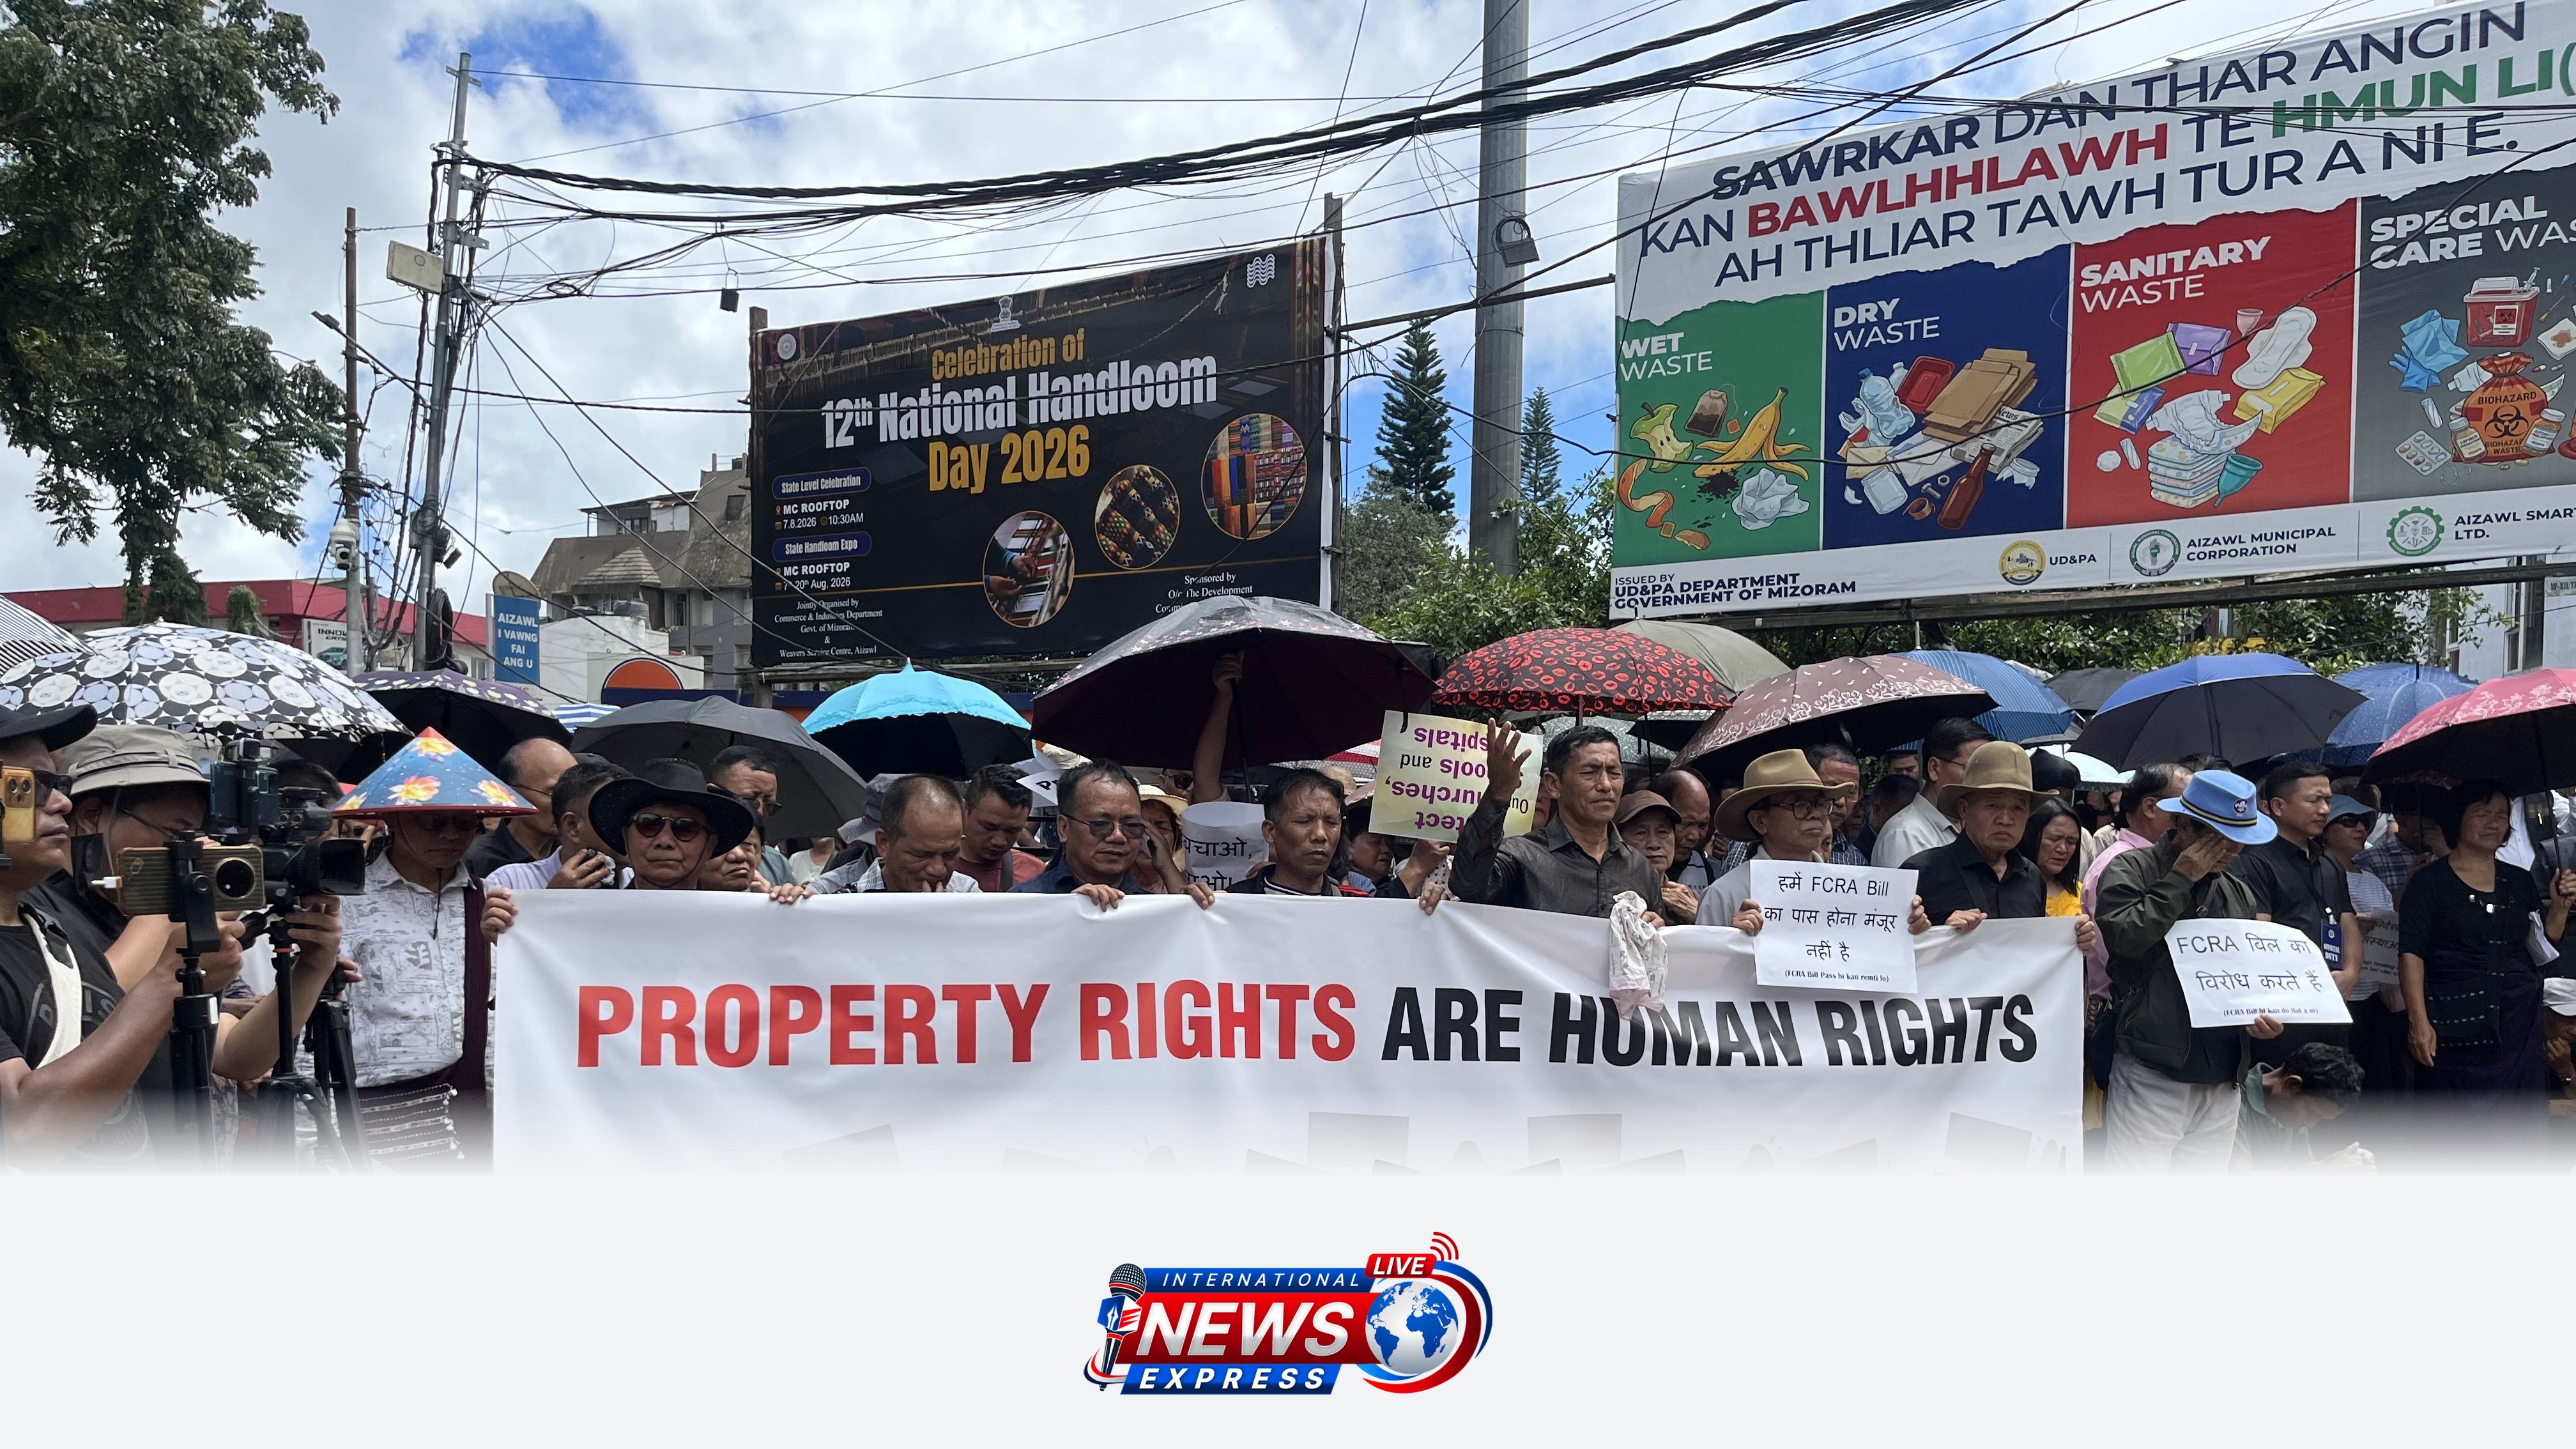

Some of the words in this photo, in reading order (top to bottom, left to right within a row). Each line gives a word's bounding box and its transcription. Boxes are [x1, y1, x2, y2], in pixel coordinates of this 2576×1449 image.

[1712, 116, 1981, 201] SAWRKAR
[1995, 84, 2117, 144] DAN
[2131, 50, 2297, 107] THAR
[2310, 1, 2526, 81] ANGIN
[1641, 210, 1733, 257] KAN
[1748, 123, 2168, 238] BAWLHHLAWH
[2182, 107, 2255, 153] TE
[2273, 64, 2476, 139] HMUN
[1715, 244, 1782, 287] AH
[1794, 210, 1975, 282] THLIAR
[1986, 172, 2165, 237] TAWH
[2179, 149, 2304, 203] TUR
[2317, 139, 2366, 182] A
[2383, 123, 2443, 170] NI
[2466, 112, 2519, 157] E.
[2370, 195, 2549, 243] SPECIAL
[2370, 232, 2483, 270] CARE
[2080, 235, 2272, 288] SANITARY
[2080, 273, 2205, 314] WASTE
[1834, 298, 1901, 328] DRY
[1834, 316, 1940, 351] WASTE
[931, 334, 1055, 381] Celebration
[1062, 327, 1085, 362] of
[1620, 332, 1685, 358] WET
[1620, 350, 1713, 382] WASTE
[821, 396, 873, 448] 12th
[879, 376, 1016, 442] National
[1029, 355, 1216, 424] Handloom
[2478, 392, 2536, 404] BIOHAZARD
[929, 440, 988, 495] Day
[1000, 424, 1090, 486] 2026
[781, 482, 799, 493] State
[801, 479, 819, 491] Level
[820, 474, 861, 490] Celebration
[783, 504, 799, 515] MC
[801, 499, 850, 512] ROOFTOP
[2455, 512, 2521, 526] AIZAWL
[2526, 507, 2576, 521] SMAR
[783, 518, 816, 529] 7.8.2026
[828, 512, 864, 525] 10:30AM
[2187, 533, 2246, 549] AIZAWL
[2251, 526, 2336, 544] MUNICIPAL
[2455, 528, 2490, 540] LTD.
[785, 543, 803, 555] State
[804, 540, 839, 553] Handloom
[841, 539, 858, 551] Expo
[2186, 543, 2297, 562] CORPORATION
[783, 566, 799, 576] MC
[802, 562, 850, 575] ROOFTOP
[2049, 554, 2097, 565] UD&PA
[811, 579, 829, 590] Aug,
[831, 577, 850, 588] 2026
[1226, 572, 1236, 583] by
[1615, 575, 1657, 585] ISSUED
[1659, 573, 1675, 583] BY
[1615, 583, 1675, 597] UD&PA
[1680, 572, 1800, 593] DEPARTMENT
[1186, 588, 1199, 598] The
[1202, 585, 1253, 597] Development
[1615, 590, 1731, 610] GOVERNMENT
[1738, 587, 1763, 600] OF
[1767, 581, 1857, 598] MIZORAM
[797, 601, 817, 611] Jointly
[819, 599, 850, 611] Organised
[851, 598, 859, 609] by
[498, 612, 538, 627] AIZAWL
[774, 614, 807, 623] Commerce
[808, 612, 814, 621] &
[847, 610, 883, 620] Department
[498, 629, 502, 638] I
[504, 631, 538, 643] VAWNG
[801, 624, 818, 633] Govt.
[818, 623, 827, 632] of
[511, 643, 525, 654] FAI
[779, 649, 806, 657] Weavers
[831, 647, 853, 656] Centre,
[854, 645, 877, 655] Aizawl
[503, 657, 524, 668] ANG
[526, 657, 533, 669] U
[1414, 727, 1490, 753] spitals
[1400, 753, 1432, 769] and
[1384, 776, 1482, 804] urches,
[1508, 797, 1529, 814] Ou
[1778, 871, 1802, 892] हमें
[1812, 876, 1858, 894] FCRA
[1867, 880, 1889, 896] Bill
[1765, 907, 1783, 922] का
[1792, 908, 1819, 924] पास
[1827, 907, 1857, 926] होना
[1864, 908, 1897, 933] मंजूर
[1805, 940, 1831, 960] नहीं
[1839, 941, 1850, 962] है
[2177, 935, 2240, 954] FCRA
[2287, 939, 2311, 953] का
[2196, 970, 2250, 991] विरोध
[2258, 970, 2300, 990] करते
[2305, 970, 2322, 992] हैं
[2223, 1008, 2244, 1017] (FCRA
[578, 983, 1051, 1068] PROPERTY
[1080, 979, 1356, 1062] RIGHTS
[1381, 986, 1524, 1062] ARE
[1548, 992, 1803, 1068] HUMAN
[1815, 993, 2037, 1066] RIGHTS
